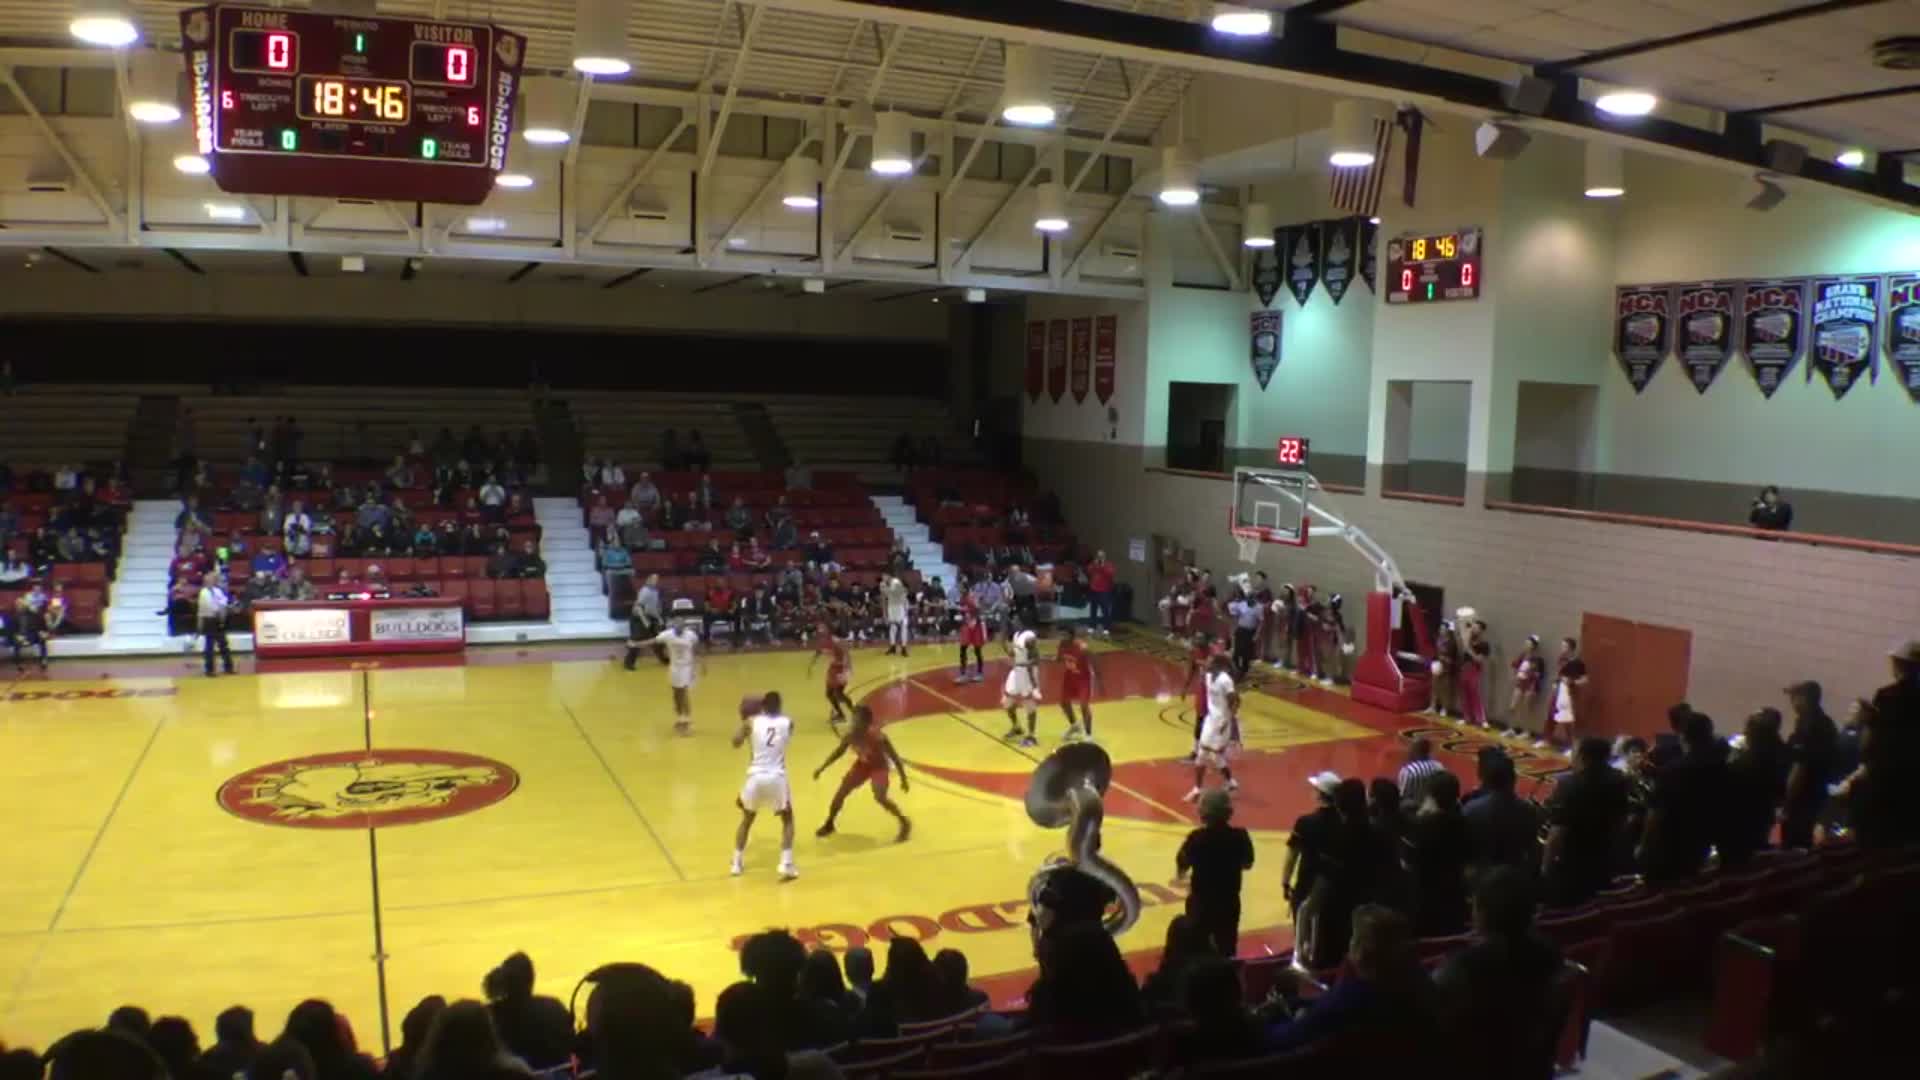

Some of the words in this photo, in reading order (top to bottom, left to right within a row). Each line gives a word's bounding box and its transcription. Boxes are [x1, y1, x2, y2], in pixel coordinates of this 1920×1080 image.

[241, 11, 289, 28] HOME
[356, 33, 363, 52] 1
[414, 24, 473, 42] VISITOR
[268, 35, 289, 68] 0
[447, 48, 468, 80] 0
[222, 90, 234, 109] 6
[314, 81, 404, 120] 18:46
[467, 107, 479, 126] 6
[281, 130, 296, 150] 0
[422, 138, 436, 158] 0
[1402, 268, 1412, 291] 0
[1461, 263, 1472, 286] 0
[1619, 293, 1668, 318] NCA
[1679, 289, 1731, 317] NCA
[1743, 286, 1801, 317] NCA
[1889, 283, 1920, 312] NC
[1280, 440, 1299, 463] 22
[375, 621, 459, 635] BULLDOGS
[766, 727, 776, 747] 2
